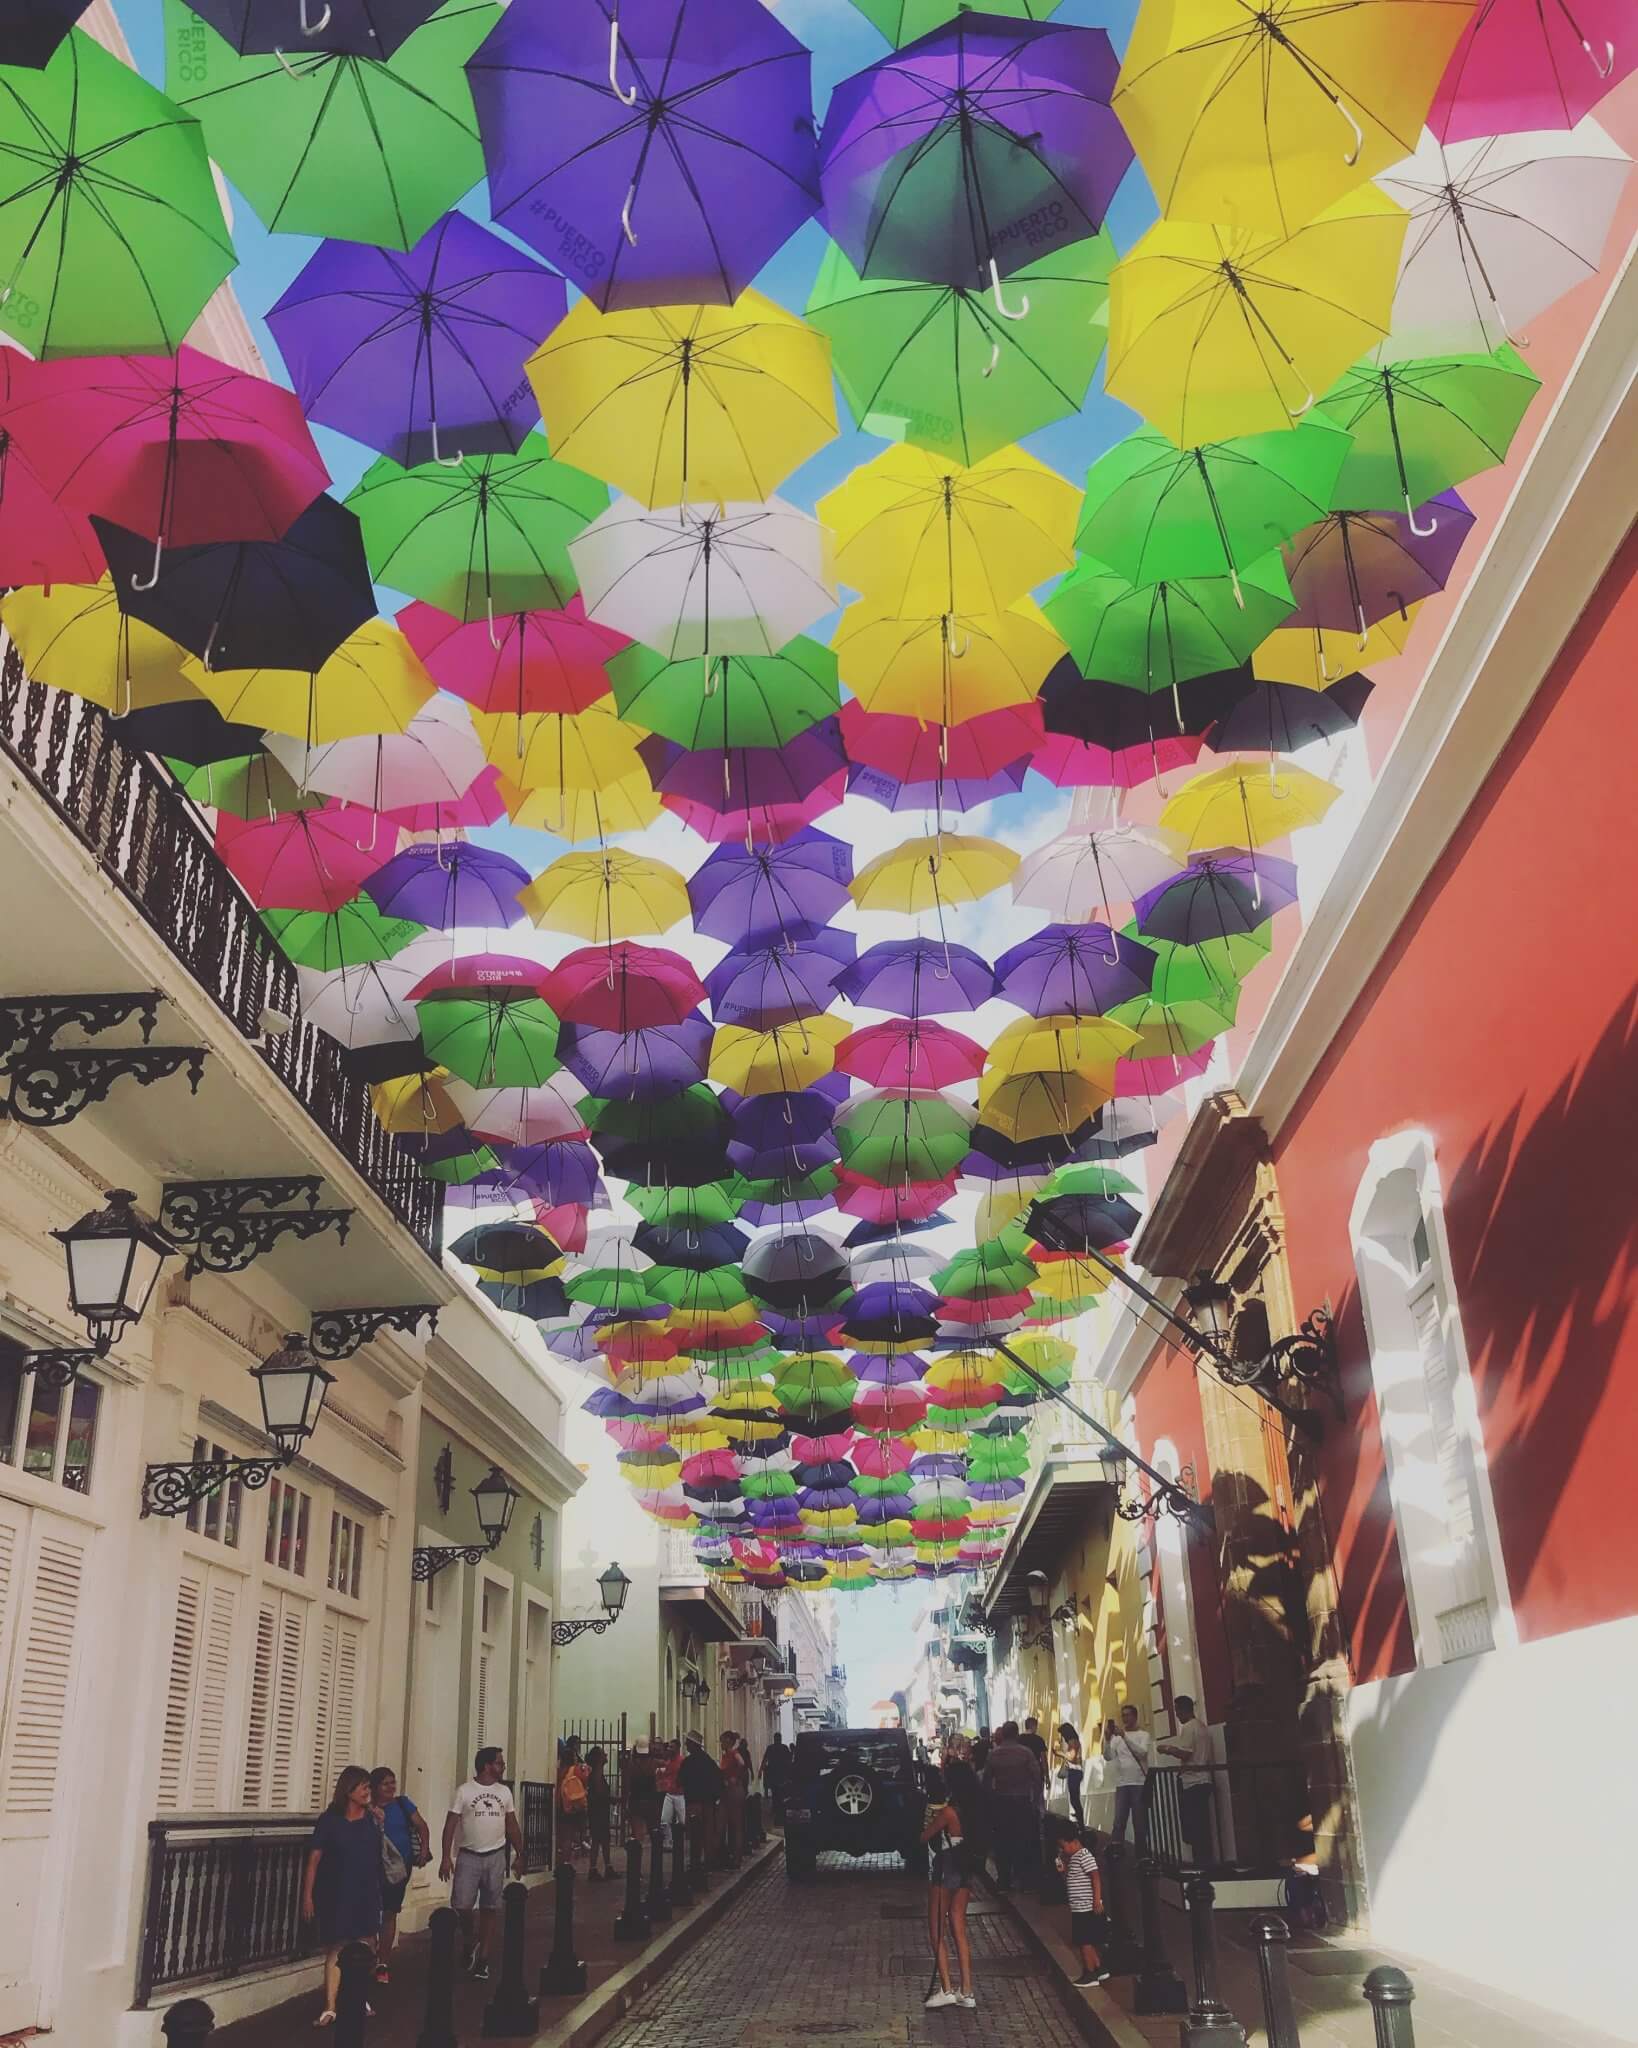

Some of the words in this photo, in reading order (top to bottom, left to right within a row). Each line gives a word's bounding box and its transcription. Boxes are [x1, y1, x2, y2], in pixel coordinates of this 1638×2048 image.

[177, 28, 193, 82] RICO
[190, 9, 207, 82] UERTO
[529, 199, 606, 267] #PUERTO
[1027, 215, 1069, 247] RICO
[557, 239, 599, 279] RICO
